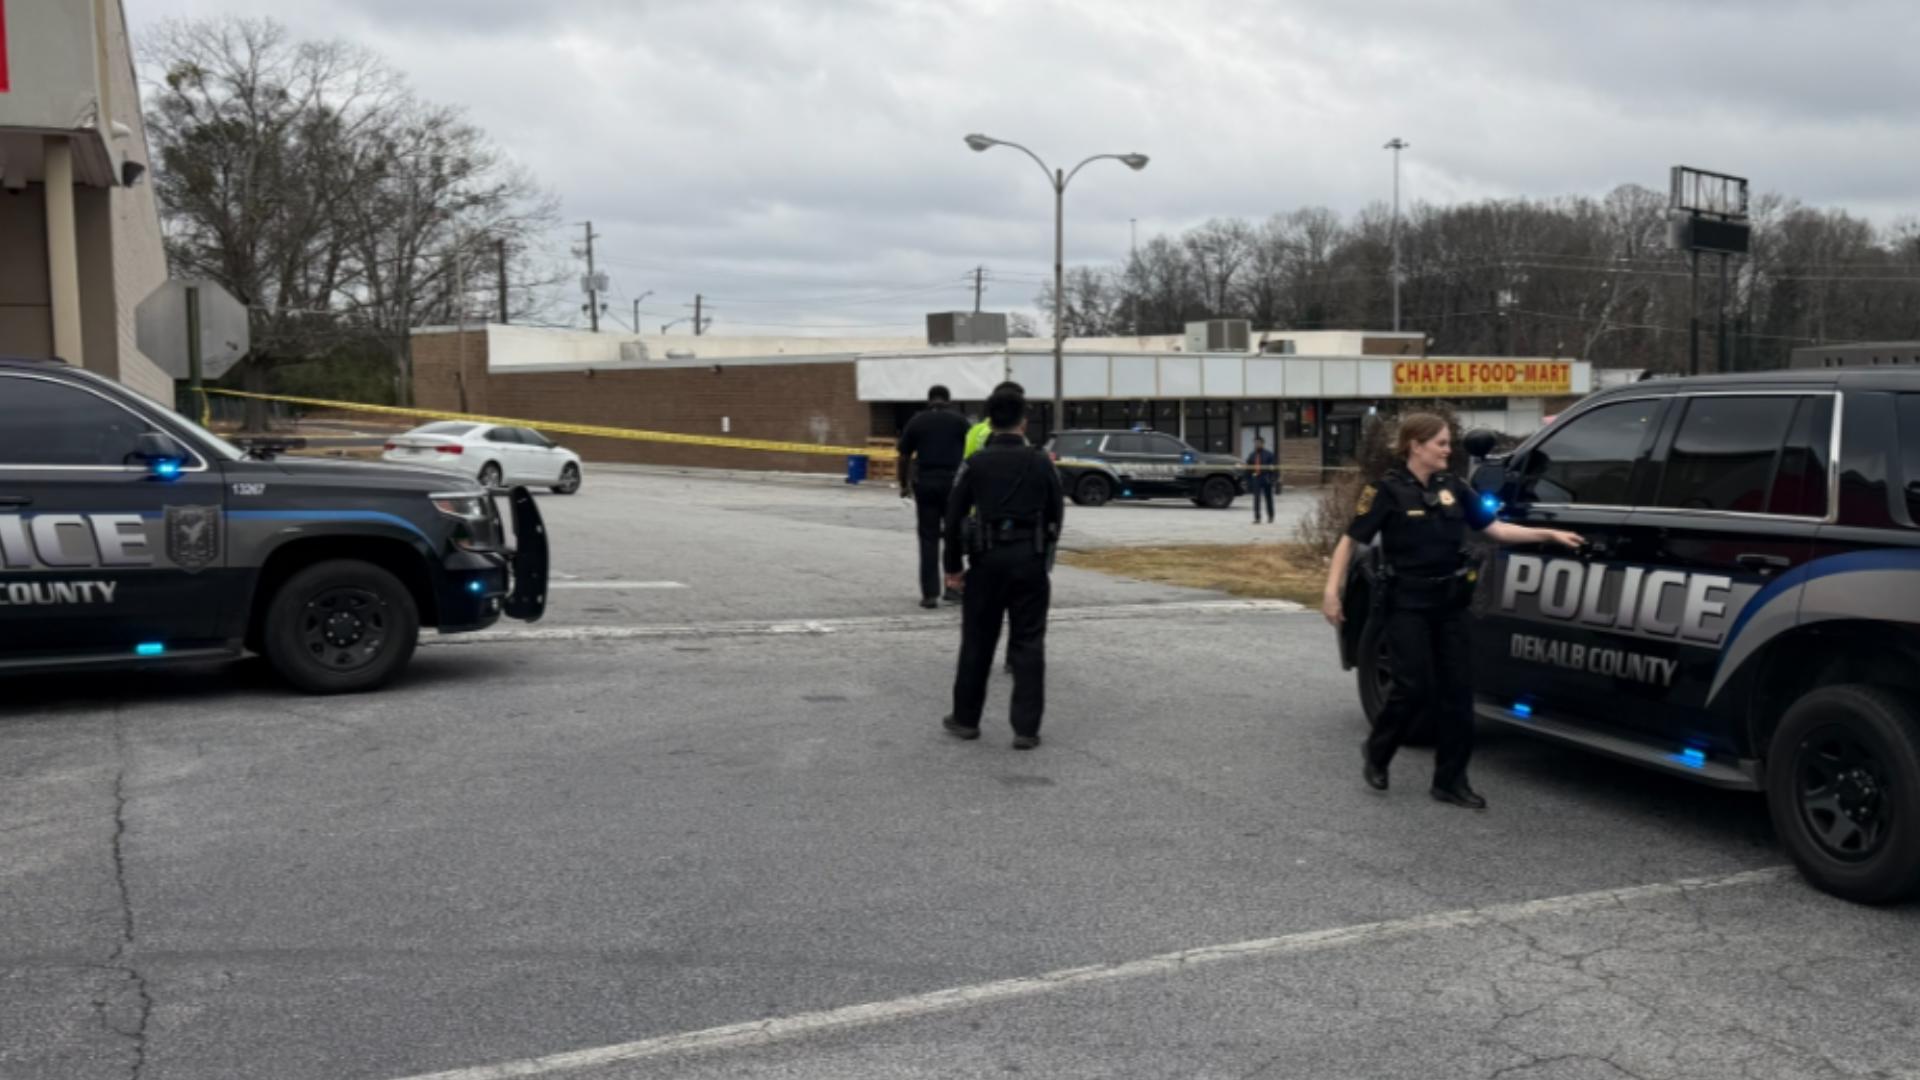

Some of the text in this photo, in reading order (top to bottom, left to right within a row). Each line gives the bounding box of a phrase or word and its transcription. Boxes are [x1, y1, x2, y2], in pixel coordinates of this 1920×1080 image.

[1394, 362, 1466, 384] CHAPEL
[1502, 553, 1732, 643] POLICE
[1510, 632, 1679, 687] DEKALB COUNTY
